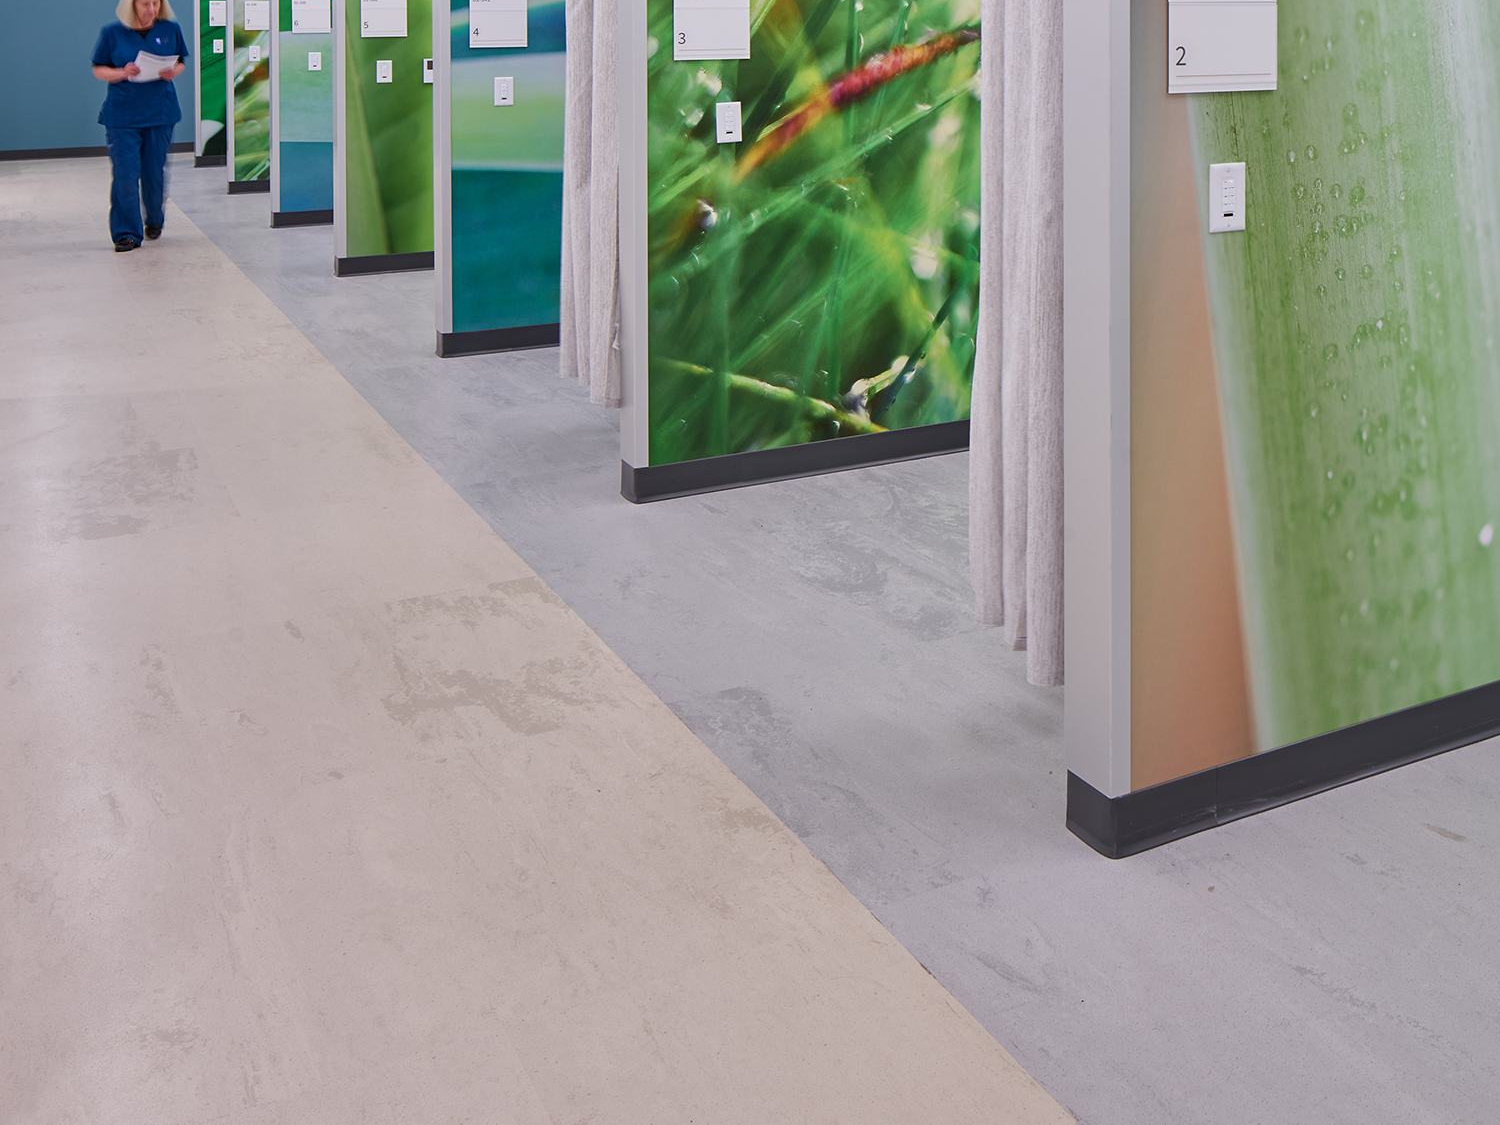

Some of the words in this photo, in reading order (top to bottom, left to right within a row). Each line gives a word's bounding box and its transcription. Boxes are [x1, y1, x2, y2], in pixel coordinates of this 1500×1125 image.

[472, 28, 480, 37] 4
[677, 32, 686, 45] 3
[1175, 46, 1187, 66] 2
